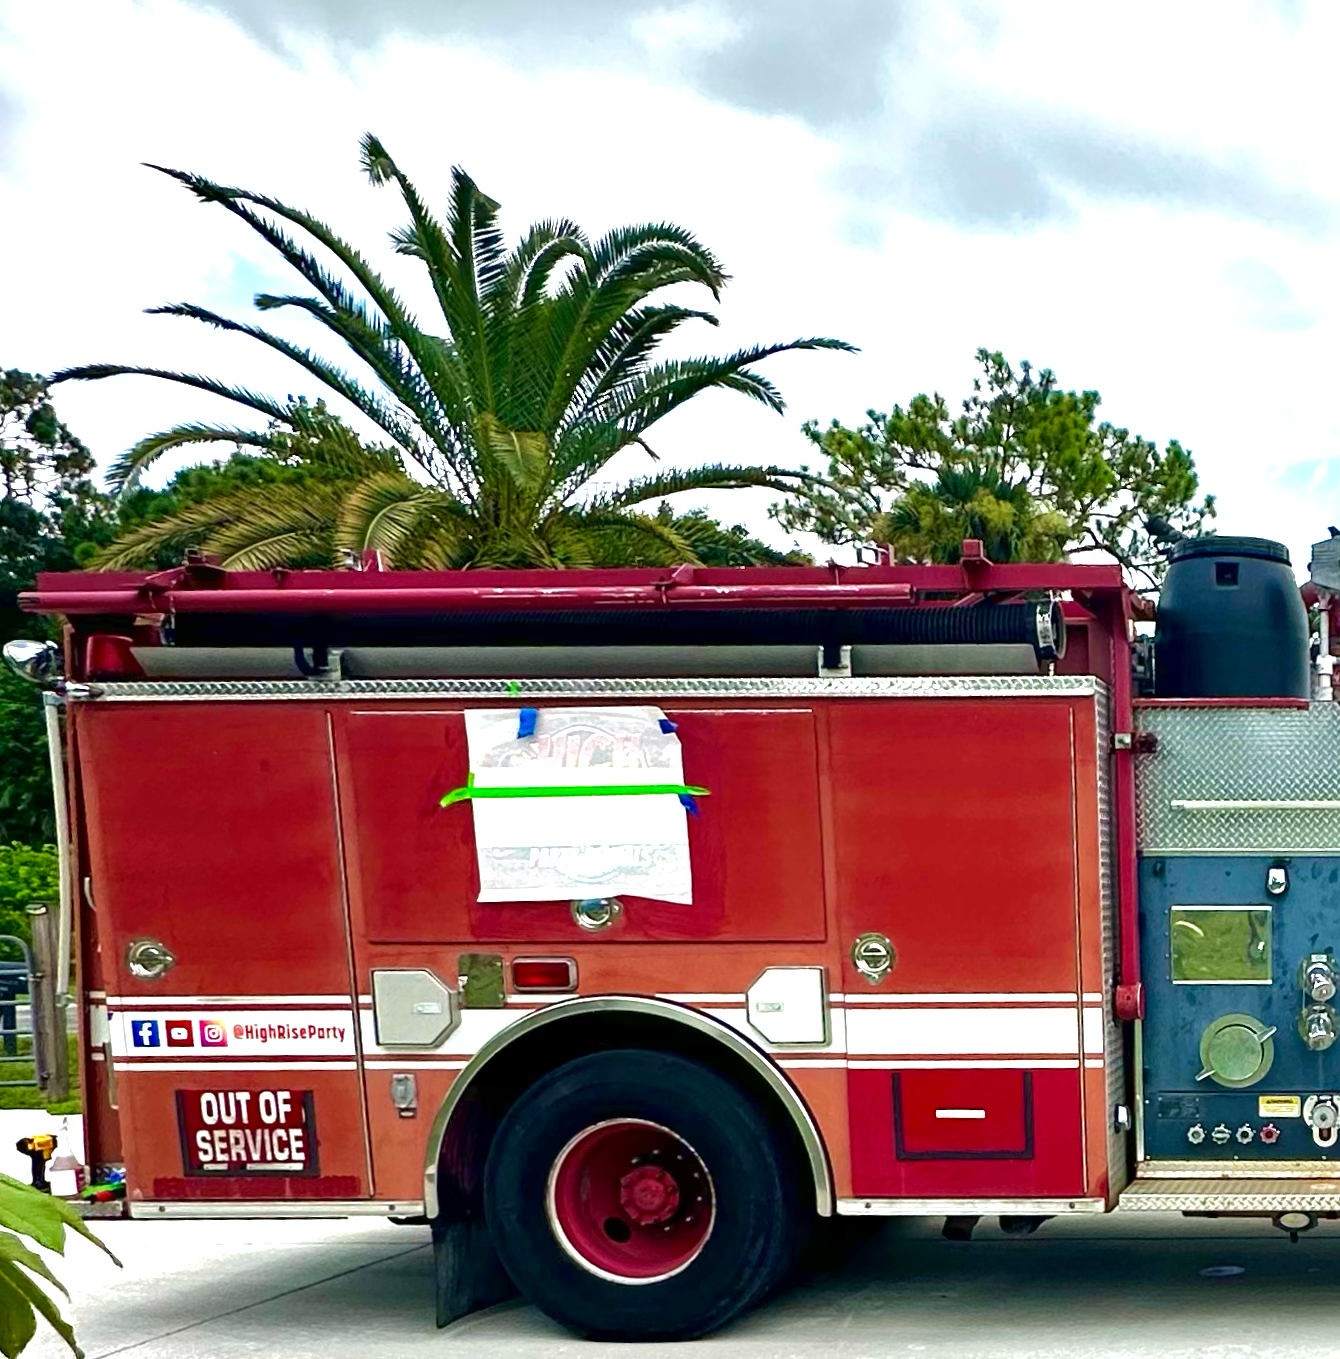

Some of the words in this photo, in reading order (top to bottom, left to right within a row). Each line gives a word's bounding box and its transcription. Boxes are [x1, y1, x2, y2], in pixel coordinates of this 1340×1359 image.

[233, 1024, 346, 1042] @HighRiseParty
[200, 1091, 251, 1125] OUT
[258, 1090, 292, 1124] OF
[195, 1128, 306, 1162] SERVICE
